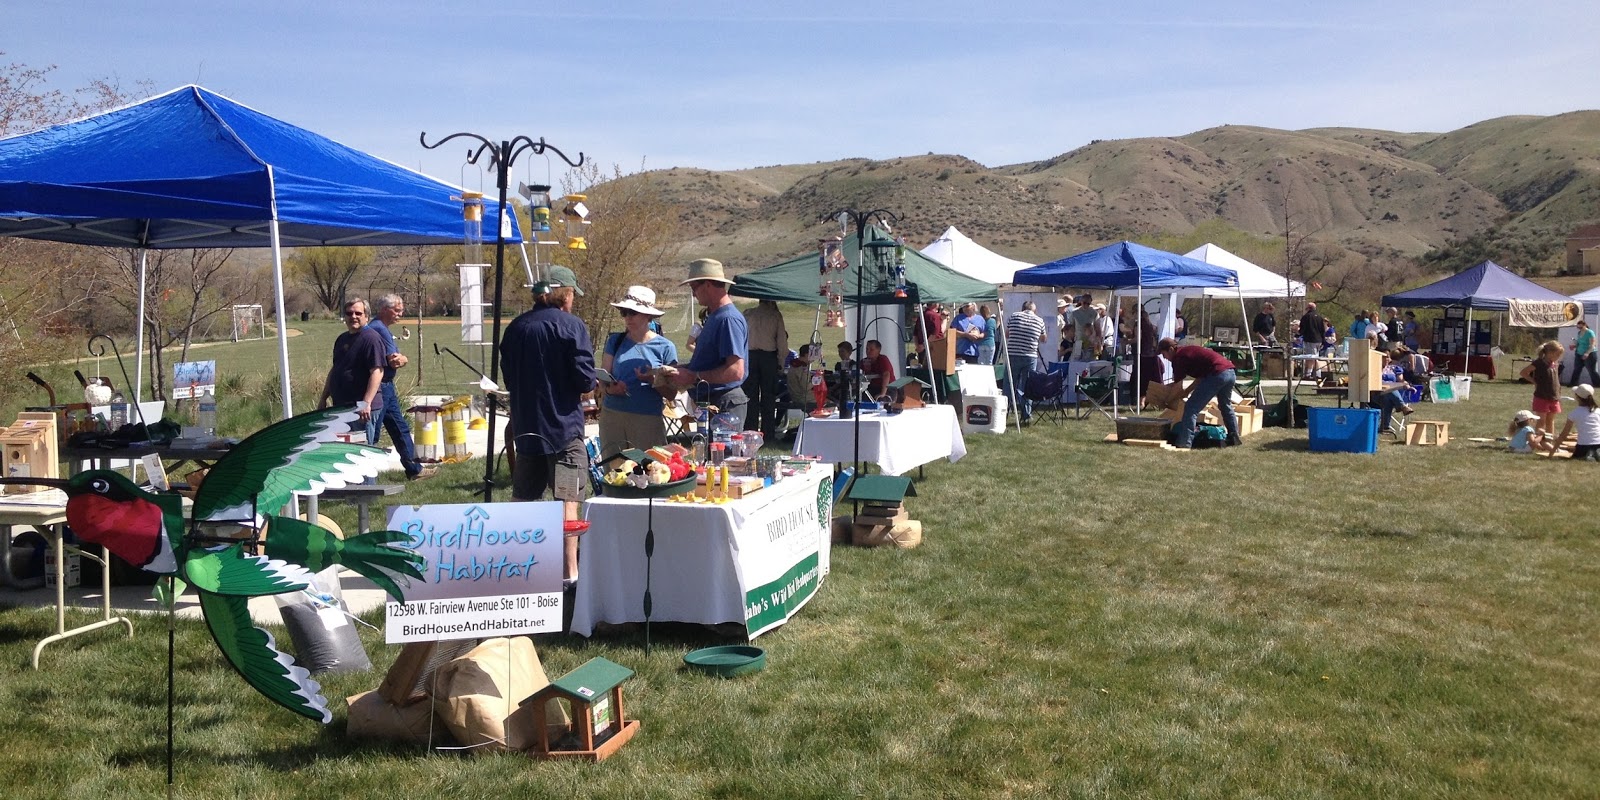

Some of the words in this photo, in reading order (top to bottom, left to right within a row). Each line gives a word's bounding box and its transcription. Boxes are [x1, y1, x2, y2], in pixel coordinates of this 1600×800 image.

[401, 513, 547, 550] BirdHouse
[766, 516, 788, 543] BIRD
[434, 550, 538, 584] Habitat
[388, 604, 416, 617] 12598
[417, 604, 428, 616] W.
[429, 602, 466, 615] Fairview
[467, 599, 498, 612] Avenue
[500, 598, 514, 611] Ste
[516, 597, 530, 609] 101
[537, 595, 559, 608] Boise
[403, 618, 546, 636] BirdHouseAndHabitat.net
